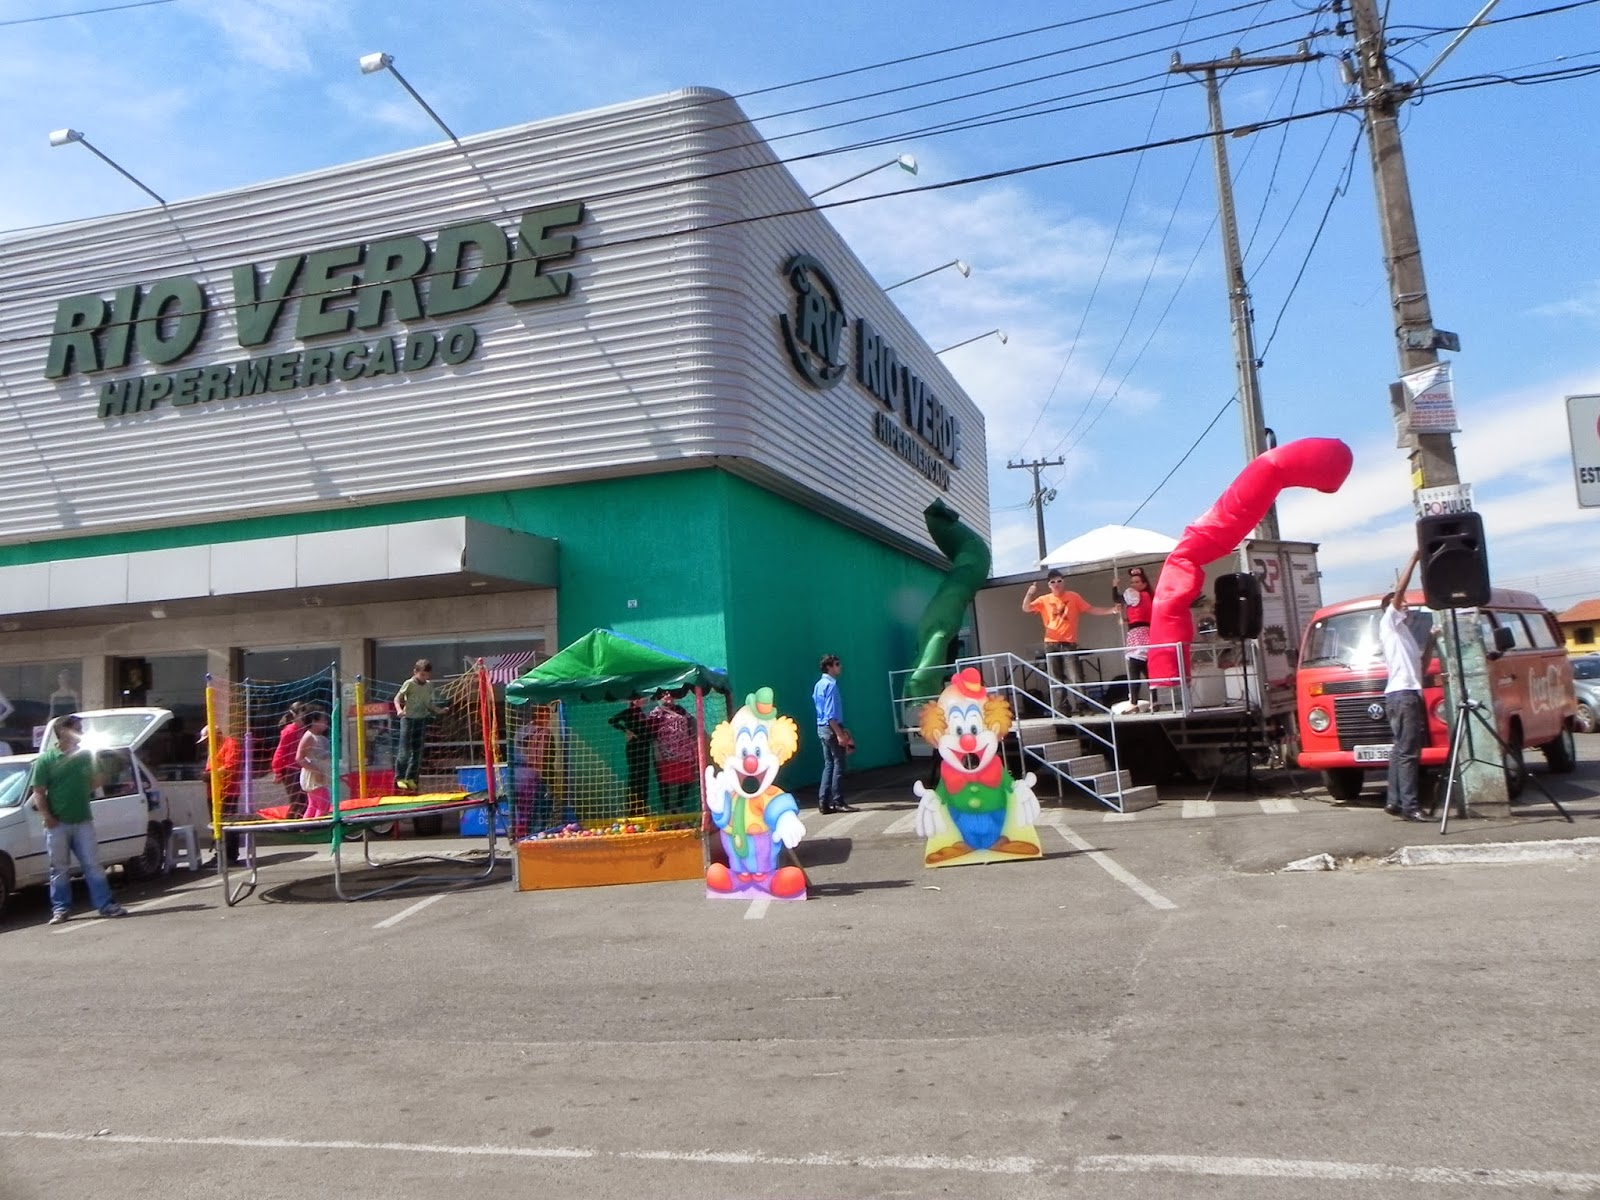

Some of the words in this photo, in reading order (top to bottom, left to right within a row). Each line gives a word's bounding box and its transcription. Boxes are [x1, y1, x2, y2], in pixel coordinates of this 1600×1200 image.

[44, 274, 208, 380] RIO
[232, 200, 586, 349] VERDE
[98, 324, 477, 419] HIPERMERCADO
[856, 318, 901, 413] RIO
[902, 366, 962, 471] VERDE
[875, 411, 951, 492] HIPERMERCADO
[1424, 498, 1474, 517] POPULAR
